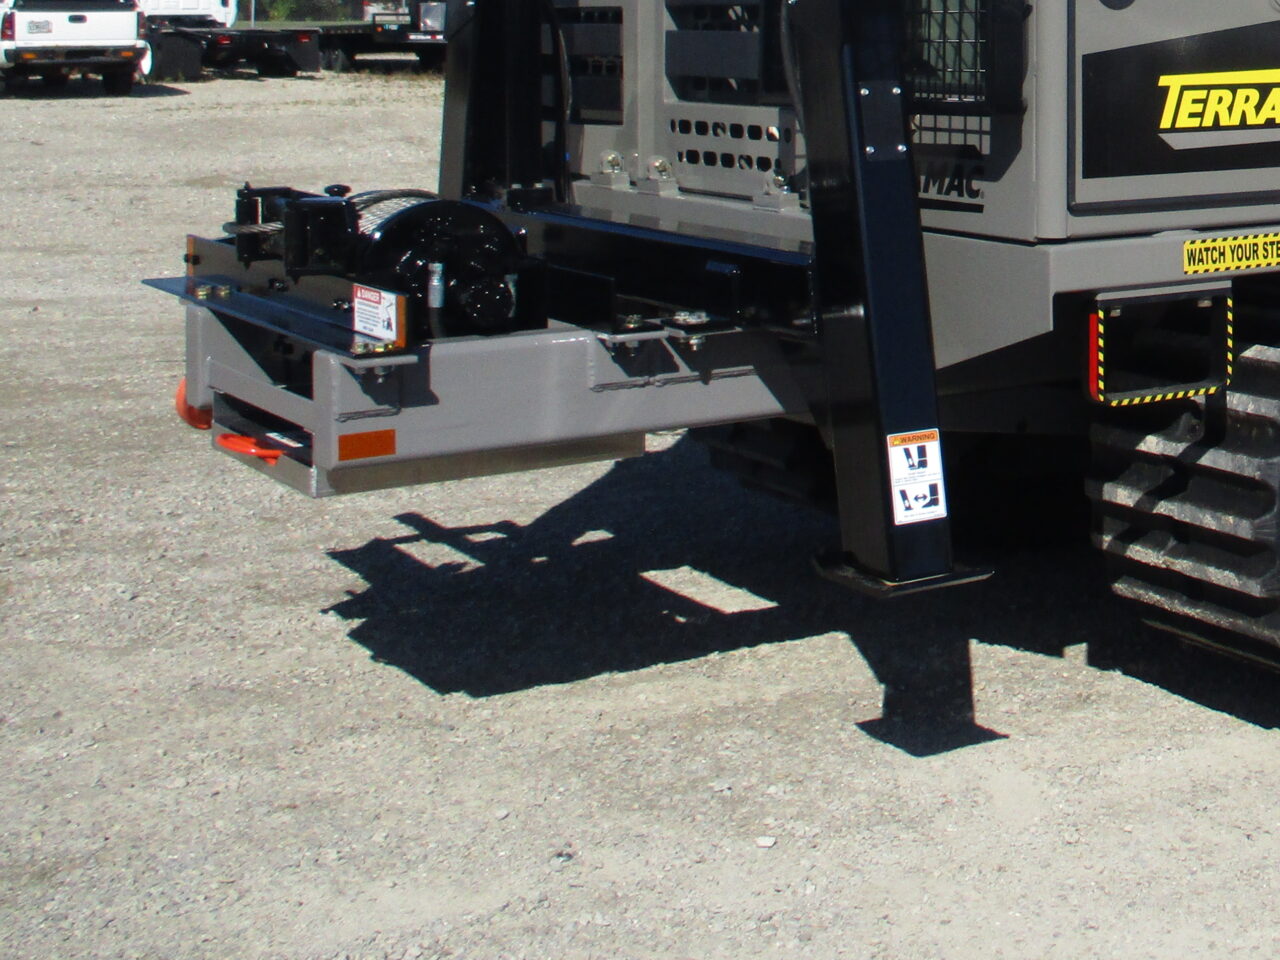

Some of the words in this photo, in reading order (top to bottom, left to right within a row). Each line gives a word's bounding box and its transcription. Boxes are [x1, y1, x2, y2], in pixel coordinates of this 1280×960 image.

[1187, 246, 1226, 267] WATCH
[1229, 242, 1260, 262] YOUR
[901, 432, 935, 444] WARNING
